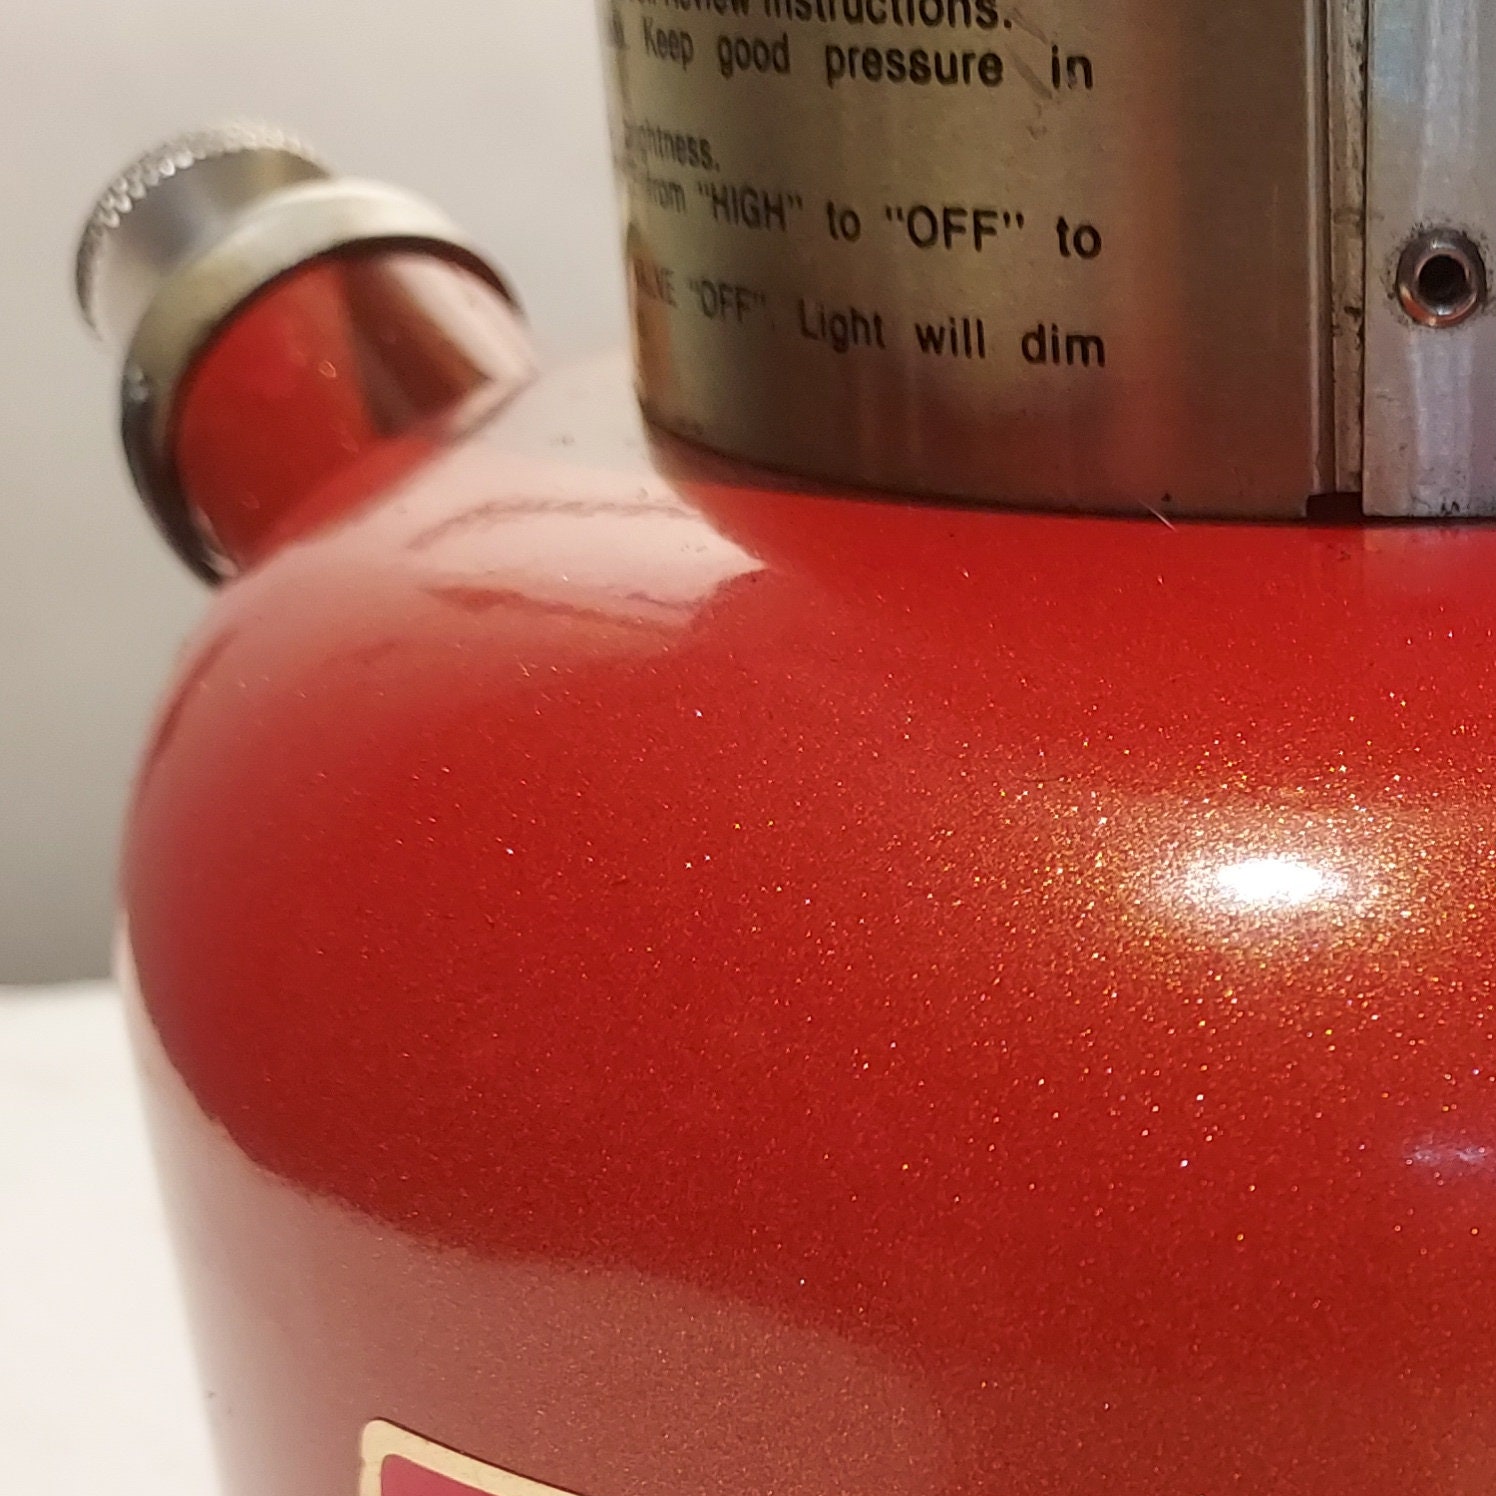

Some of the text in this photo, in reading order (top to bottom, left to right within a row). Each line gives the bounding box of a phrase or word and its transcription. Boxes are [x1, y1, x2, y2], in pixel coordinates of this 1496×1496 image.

[643, 16, 695, 72] Keep
[717, 32, 791, 80] good
[825, 42, 1003, 90] pressure
[1051, 44, 1093, 90] in
[622, 118, 721, 173] htness.
[826, 202, 862, 242] to
[885, 204, 1024, 252] "OFF"
[1056, 217, 1101, 259] to
[799, 297, 886, 354] Light
[915, 316, 985, 359] will
[1021, 322, 1105, 367] dim
